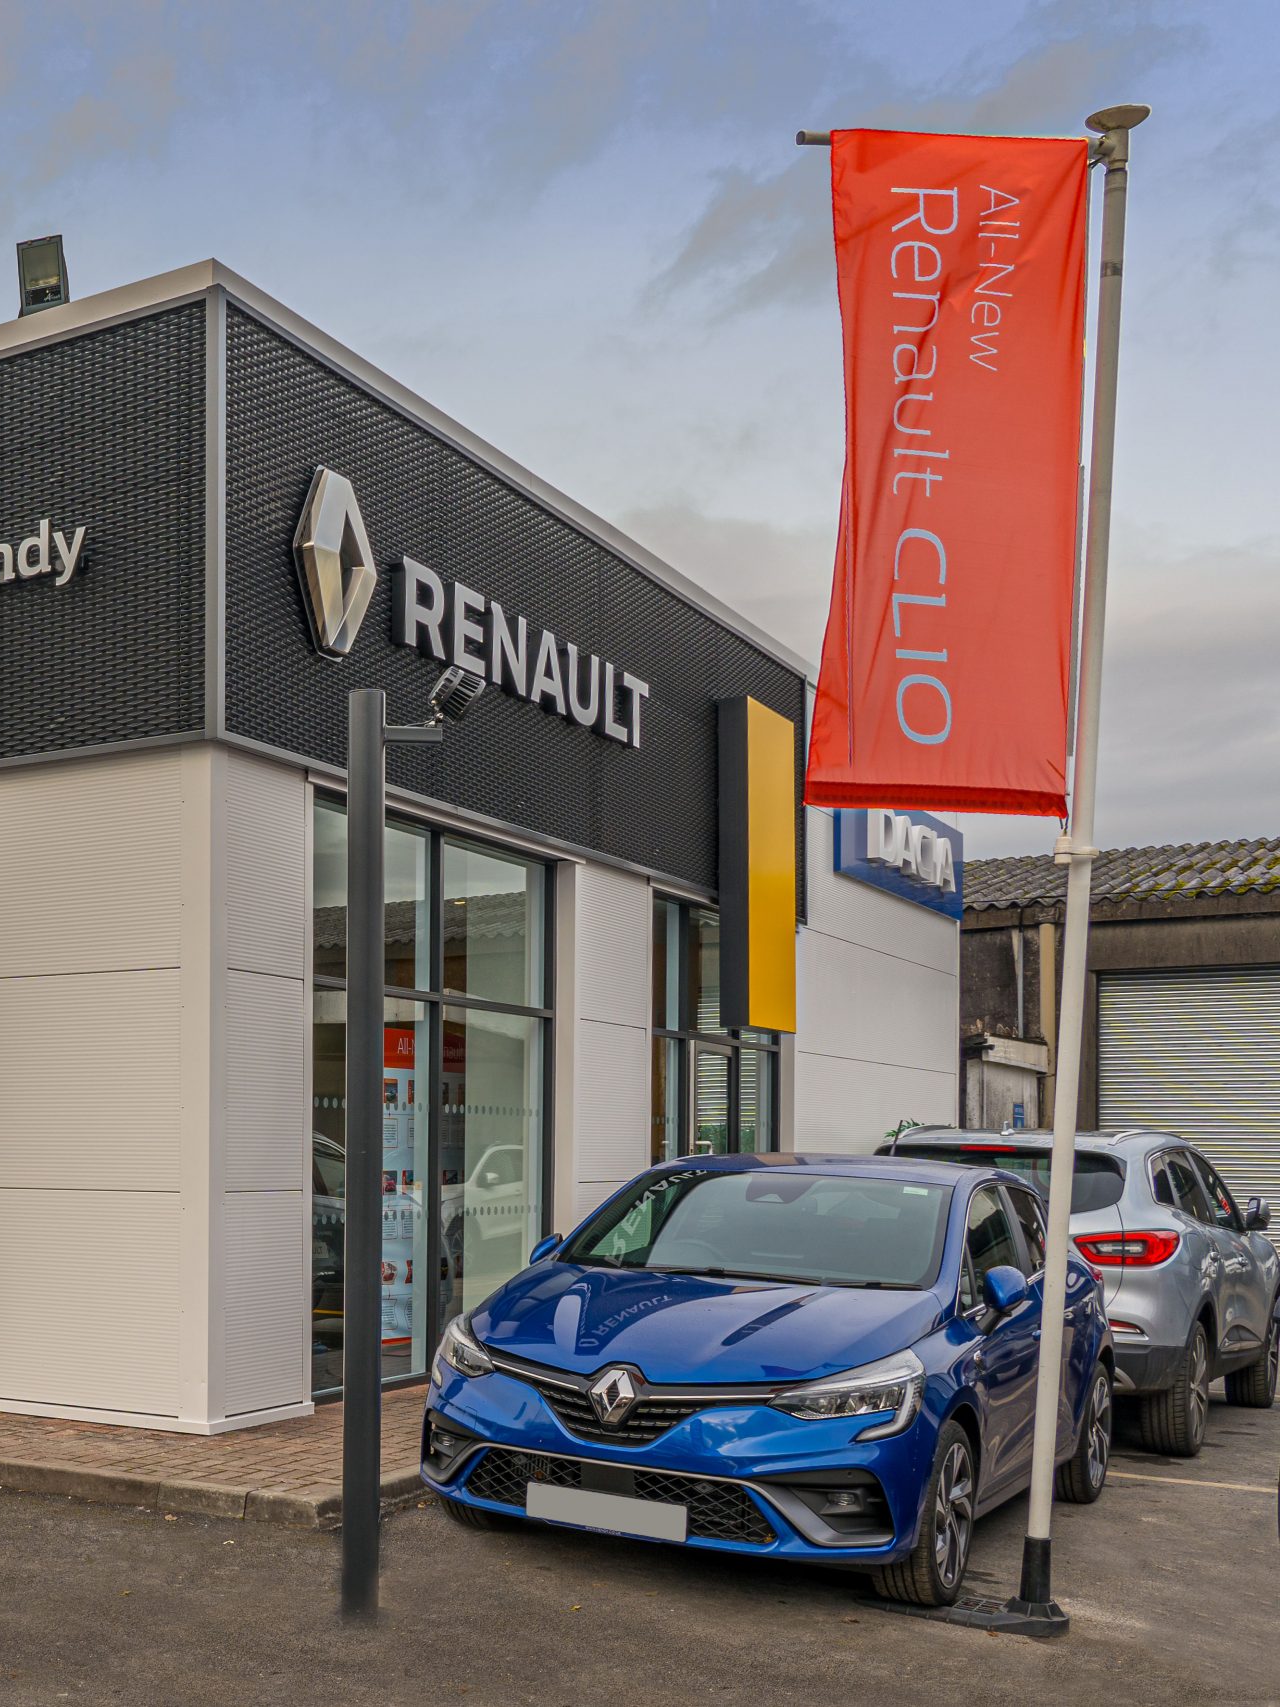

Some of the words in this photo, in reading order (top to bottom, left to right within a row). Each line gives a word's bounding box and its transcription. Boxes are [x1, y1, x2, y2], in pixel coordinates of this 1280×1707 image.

[890, 186, 959, 497] Renault
[969, 184, 1021, 372] All-New
[402, 555, 650, 749] RENAULT
[892, 528, 952, 745] CLIO
[868, 809, 957, 893] DACIA
